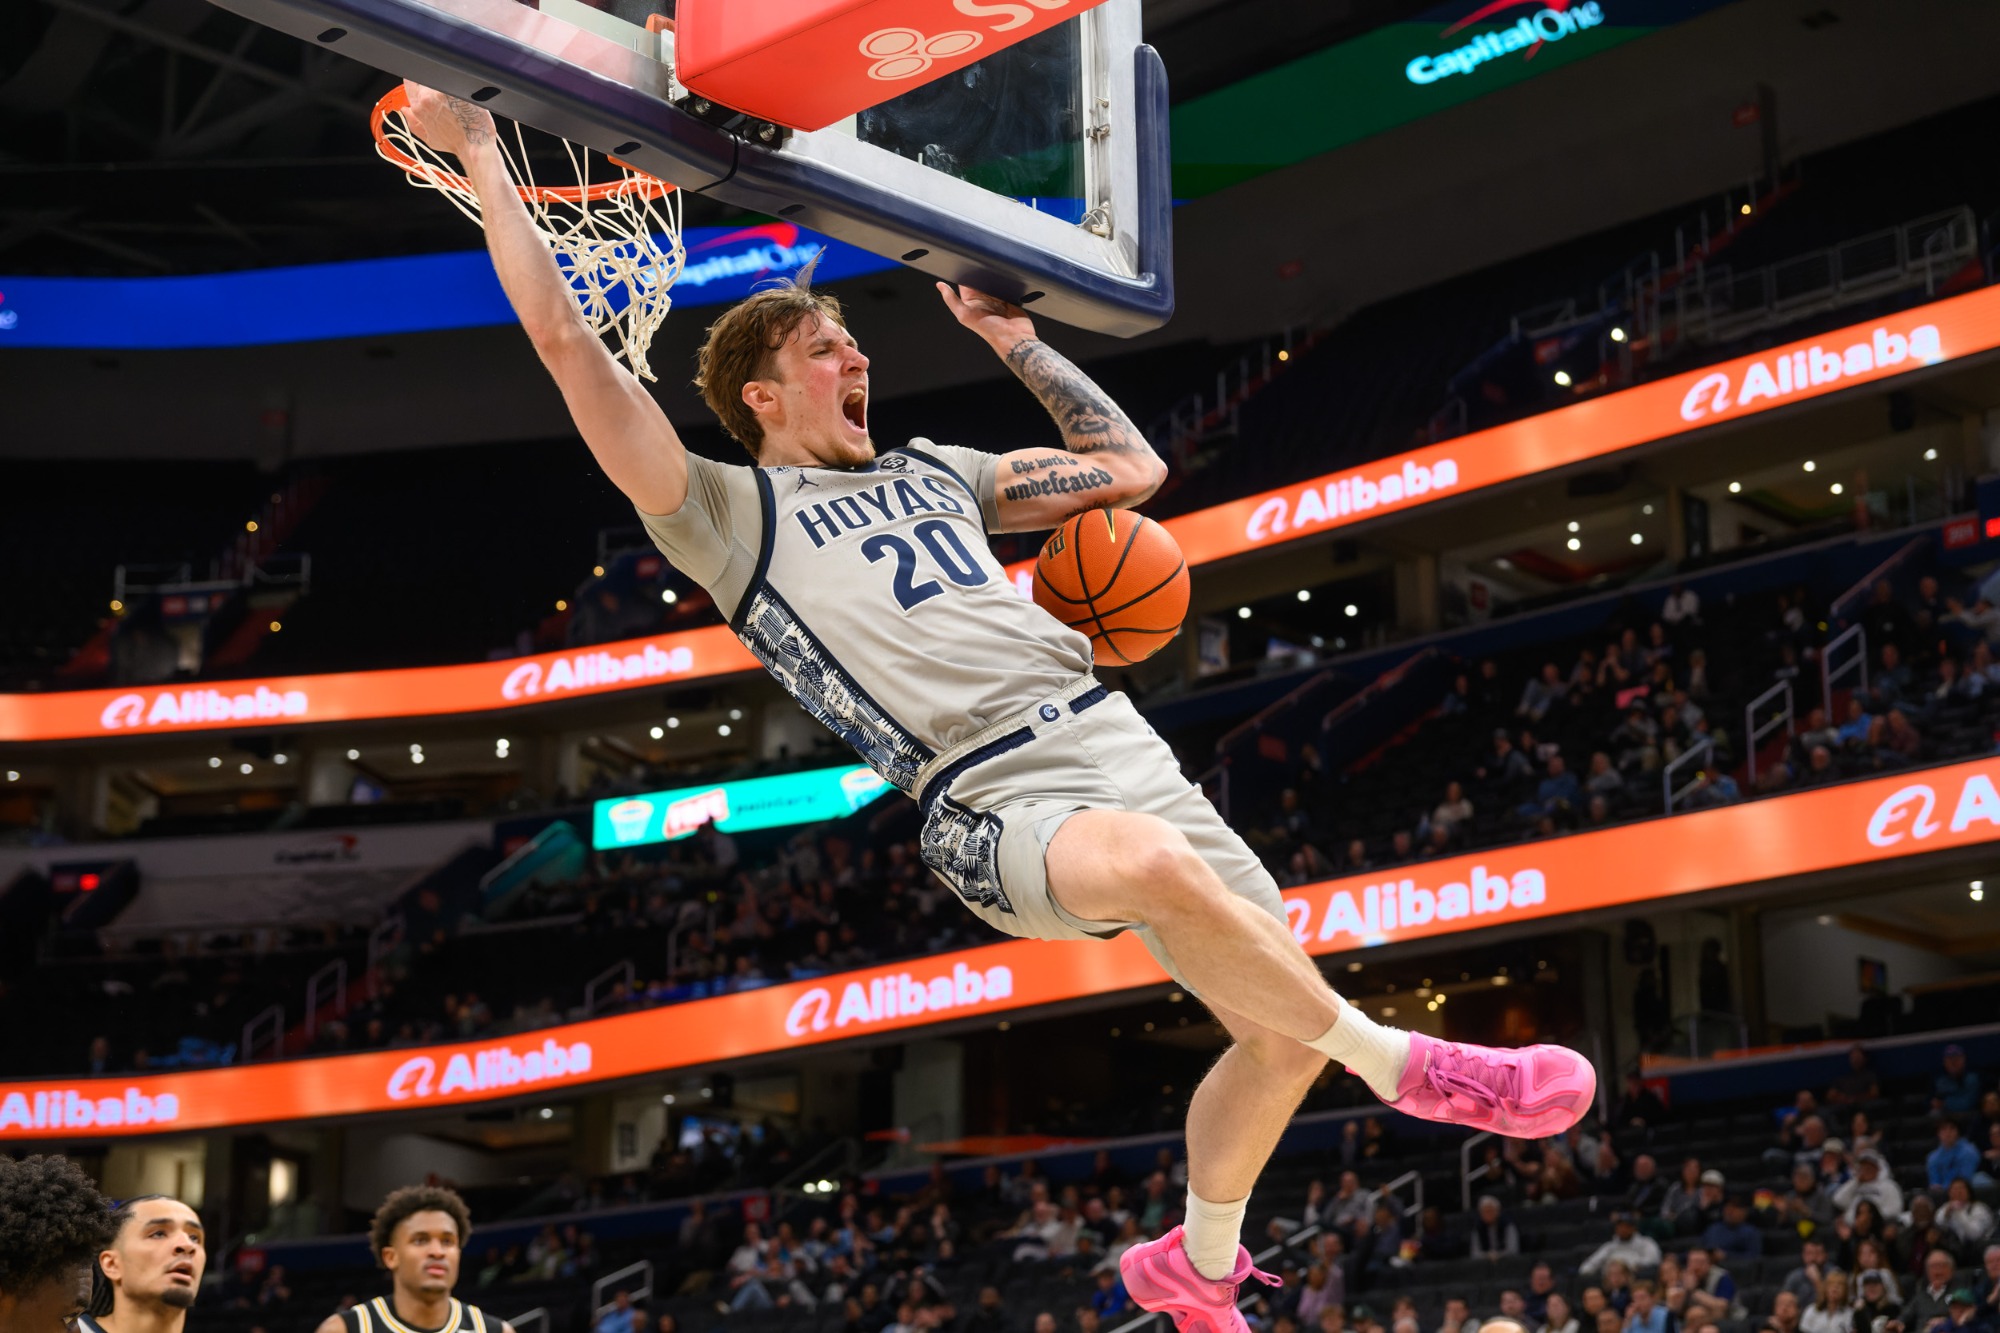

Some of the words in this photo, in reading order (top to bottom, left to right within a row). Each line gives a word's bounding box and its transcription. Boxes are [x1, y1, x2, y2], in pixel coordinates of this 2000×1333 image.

[1738, 325, 1940, 406] Alibaba
[1004, 466, 1114, 501] undefeated
[1010, 459, 1035, 474] The
[1035, 455, 1066, 469] work
[795, 475, 965, 550] HOYAS
[1293, 459, 1458, 528] Alibaba
[860, 519, 990, 612] 20
[544, 645, 693, 693] Alibaba
[147, 686, 308, 725] Alibaba
[1038, 703, 1061, 723] G
[1318, 866, 1546, 941] Alibaba
[835, 962, 1013, 1027] Alibaba
[439, 1039, 592, 1094] Alibaba
[0, 1087, 179, 1130] Alibaba
